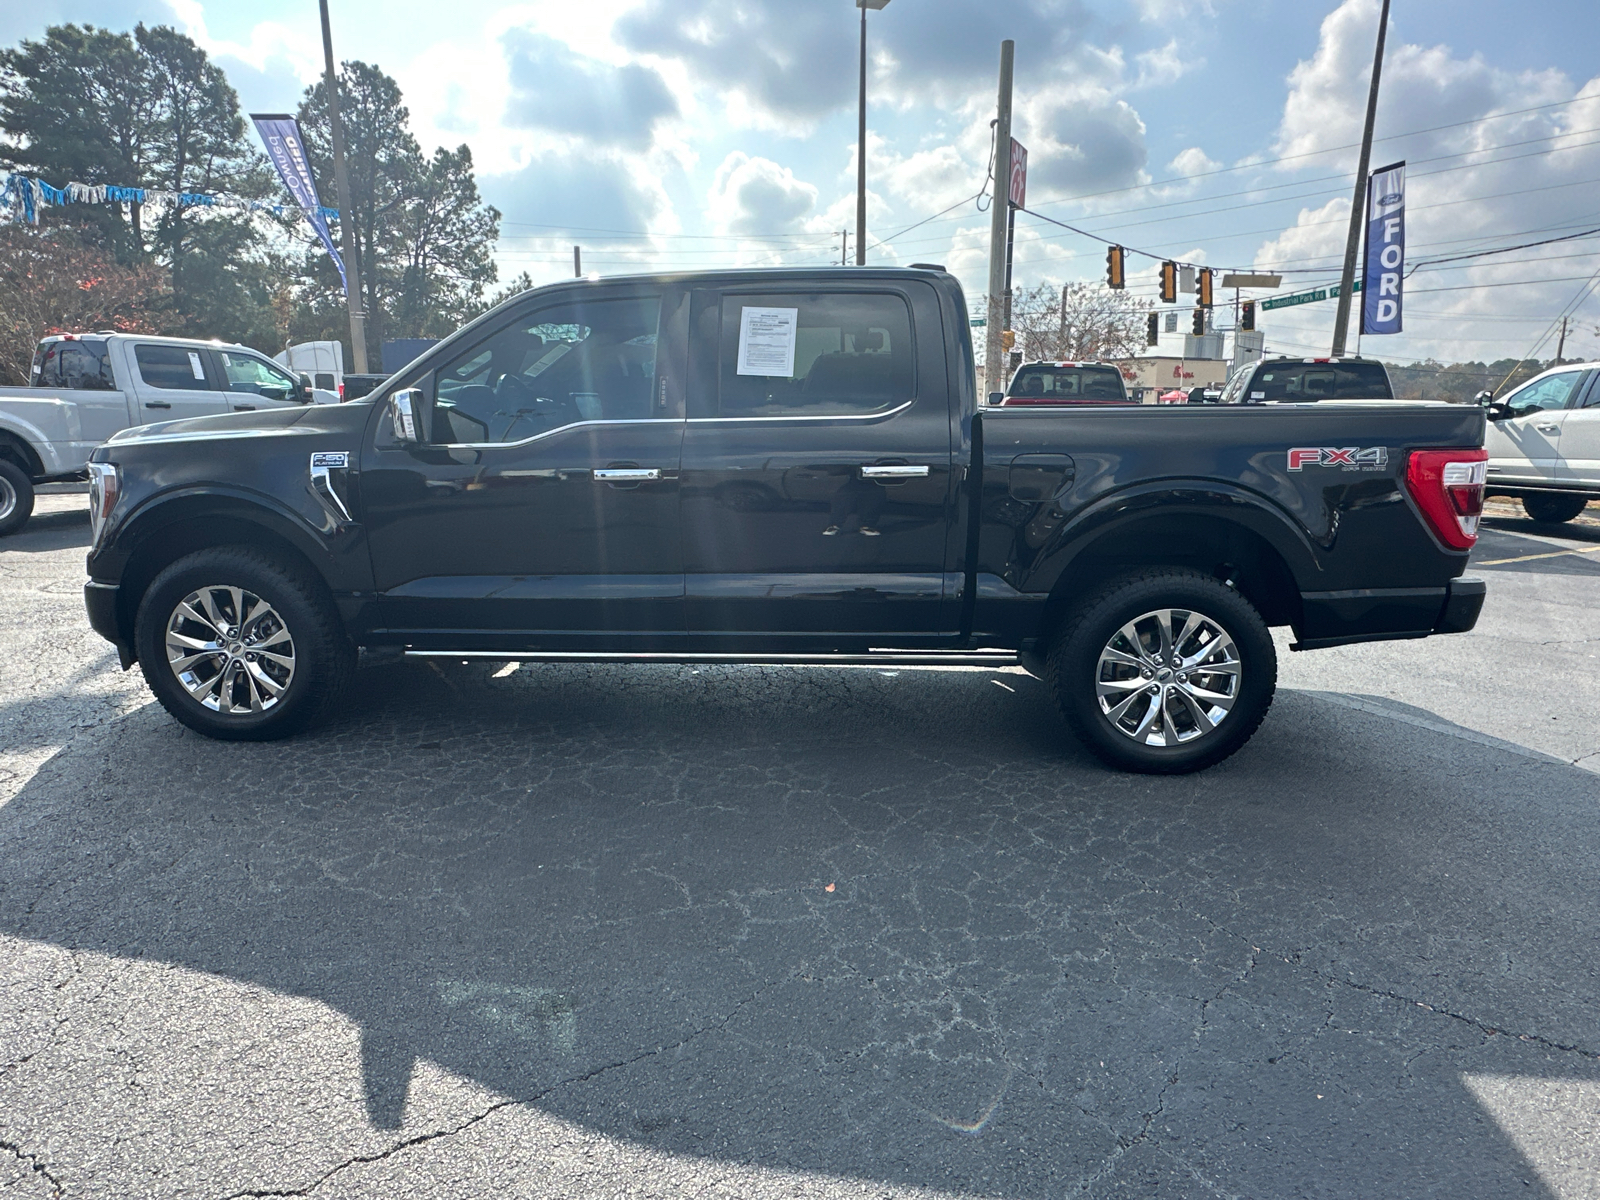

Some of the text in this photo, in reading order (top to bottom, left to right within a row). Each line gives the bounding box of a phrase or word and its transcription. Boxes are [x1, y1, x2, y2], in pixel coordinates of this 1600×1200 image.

[1382, 194, 1400, 205] Ford
[1376, 217, 1402, 322] FORD
[1272, 291, 1324, 308] Industrial Park Rd
[1287, 447, 1388, 472] FX4
